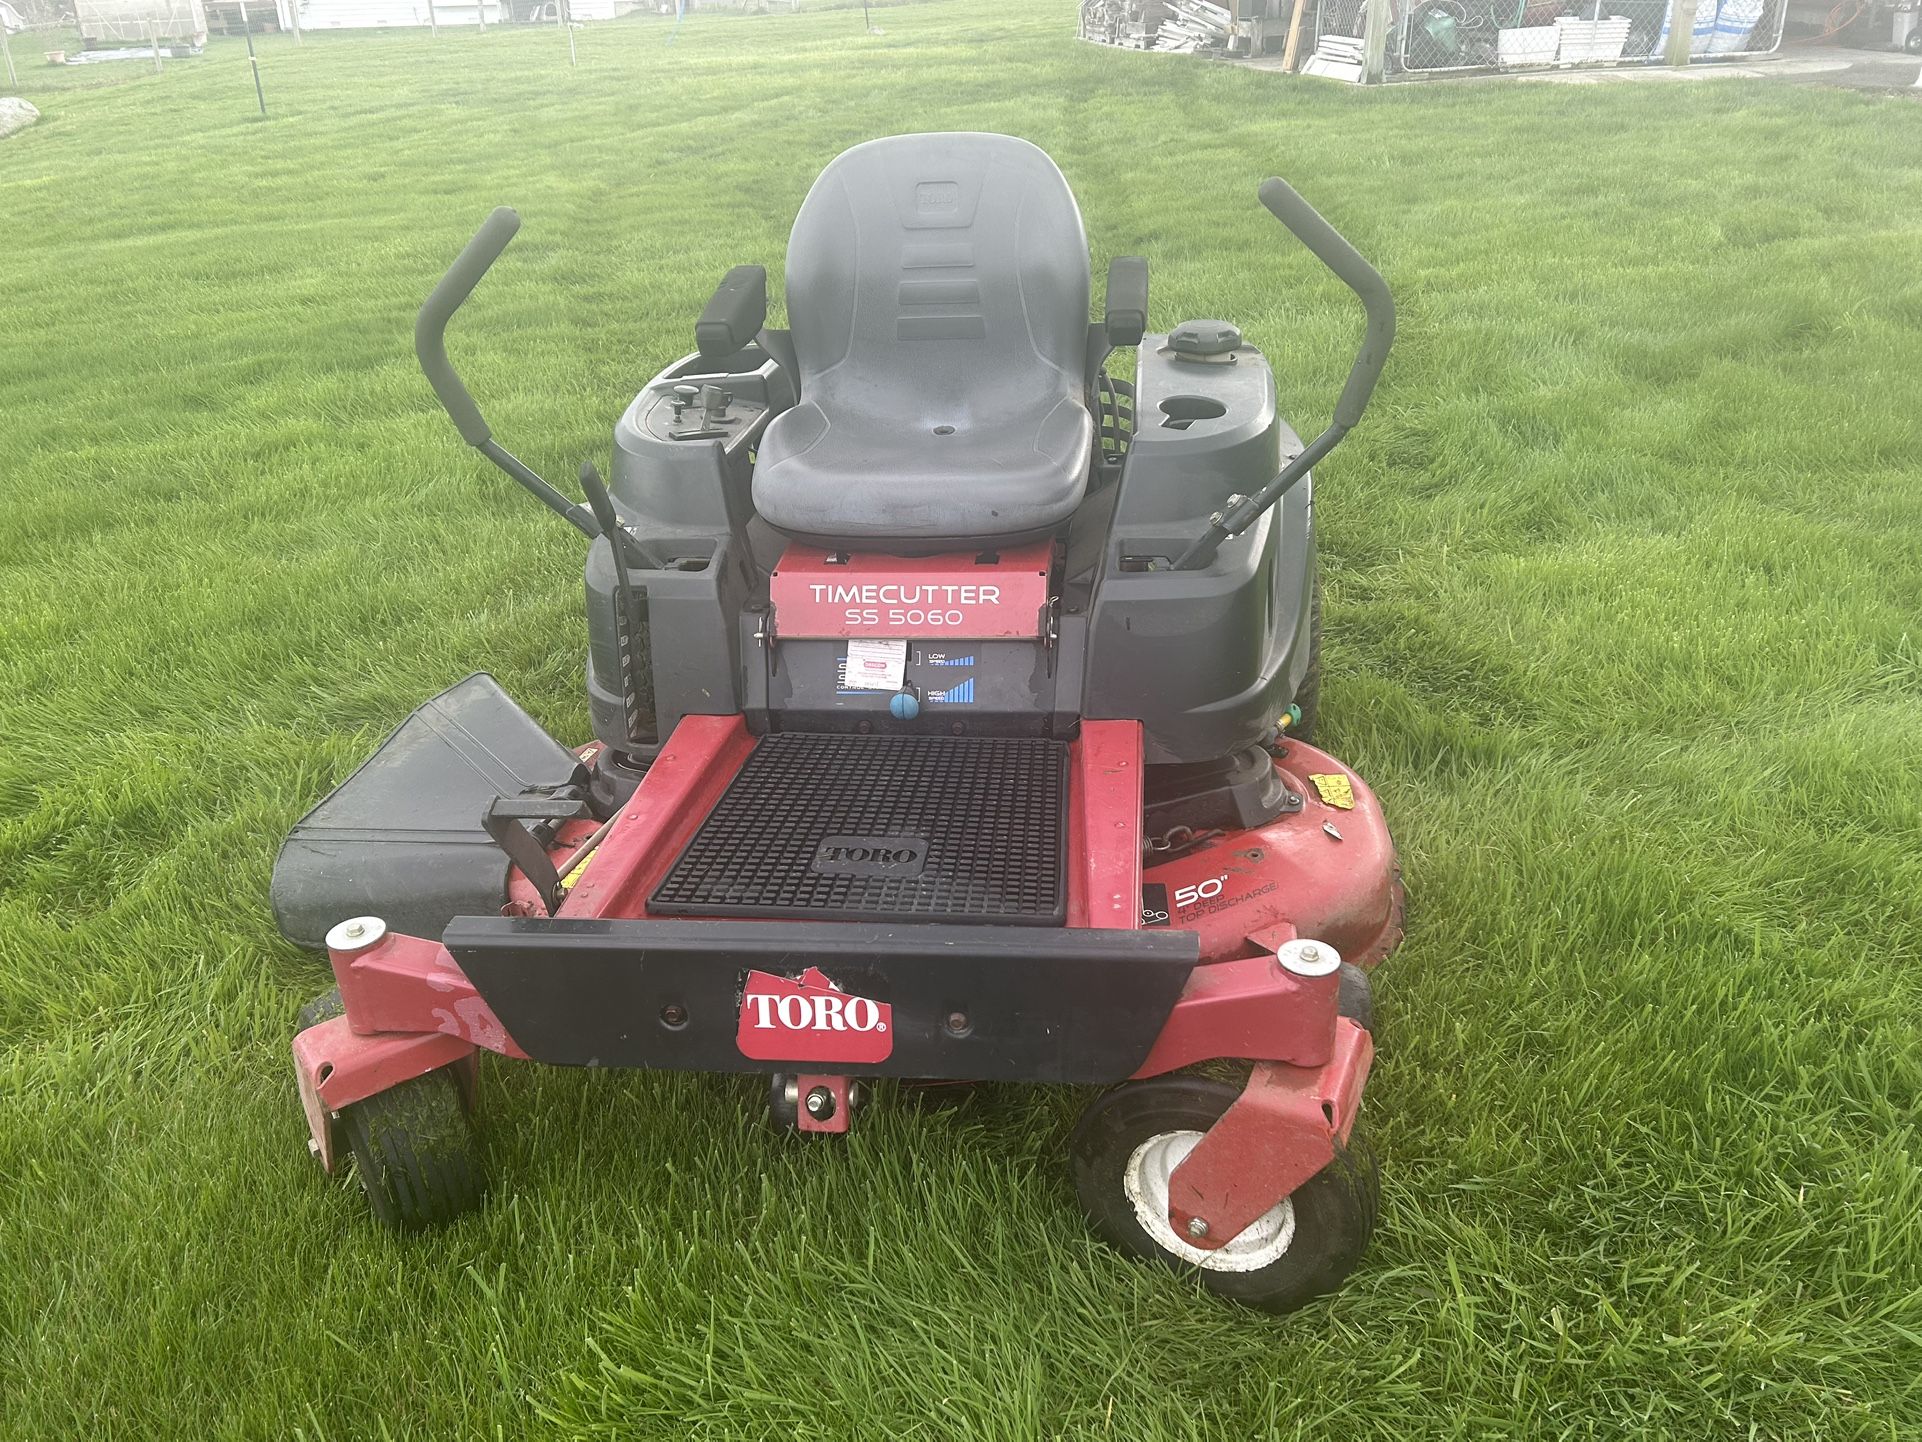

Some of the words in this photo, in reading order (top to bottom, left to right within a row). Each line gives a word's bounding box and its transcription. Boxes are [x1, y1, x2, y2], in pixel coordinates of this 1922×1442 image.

[809, 584, 1000, 605] TIMECUTTER
[845, 609, 879, 625] SS
[889, 609, 963, 625] 5060
[825, 846, 918, 864] TORO
[1174, 874, 1229, 908] 50"
[1179, 909, 1206, 924] TOP
[1208, 882, 1278, 914] DISCHARGE
[1193, 894, 1226, 911] DEEP
[747, 994, 881, 1032] TORO
